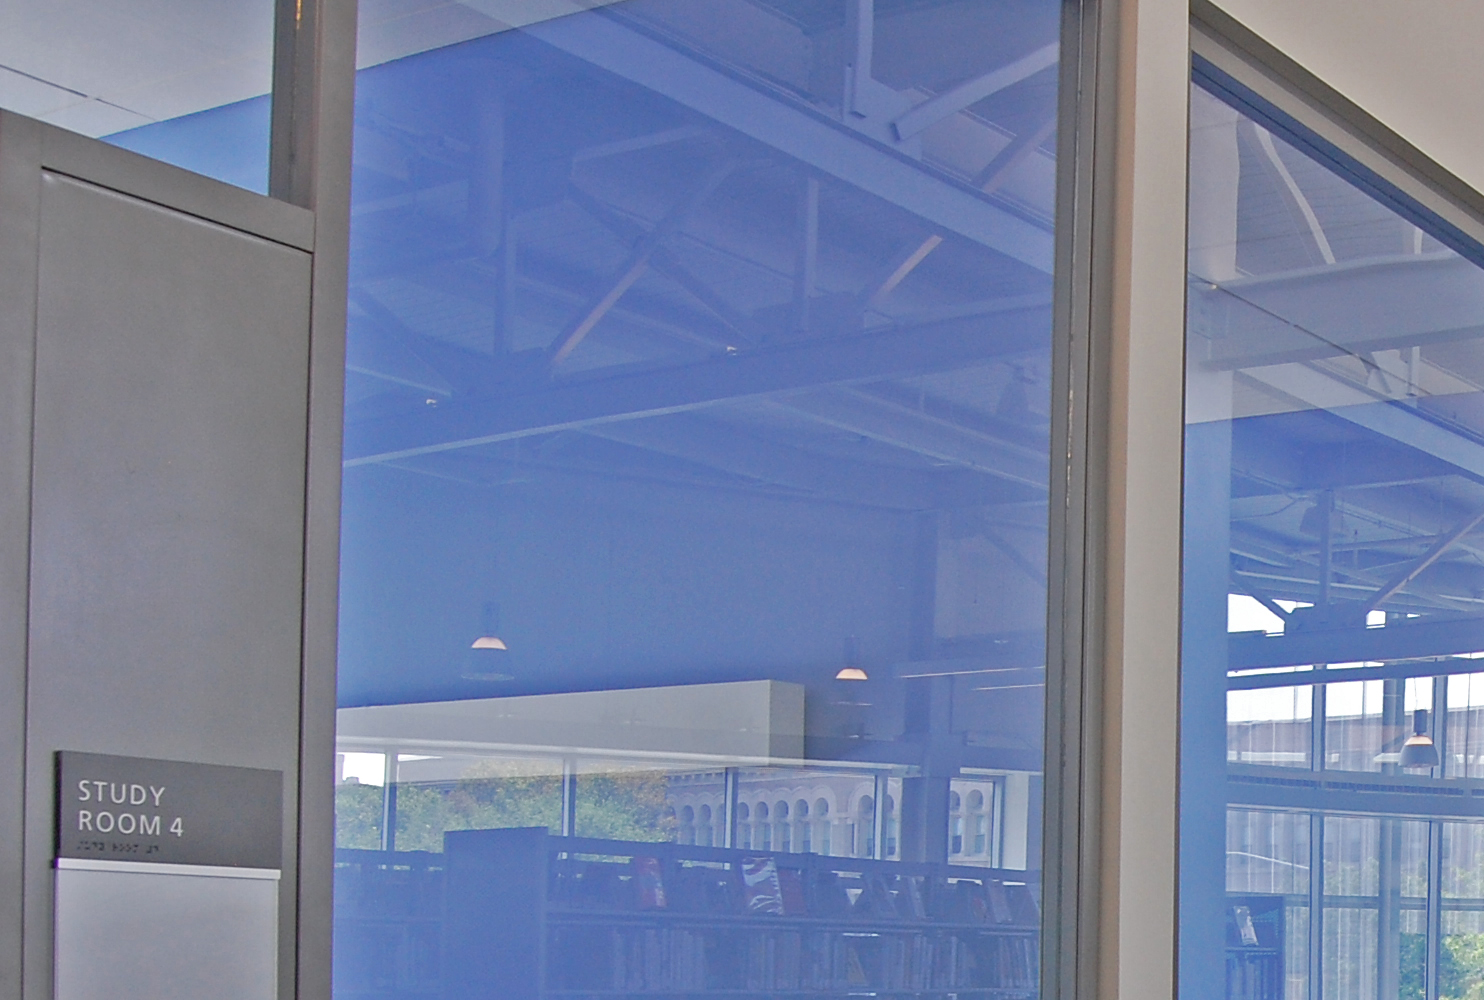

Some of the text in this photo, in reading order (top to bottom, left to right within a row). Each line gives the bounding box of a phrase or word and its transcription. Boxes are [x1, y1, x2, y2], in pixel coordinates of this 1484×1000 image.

[78, 780, 165, 807] STUDY
[78, 810, 184, 837] ROOM 4
